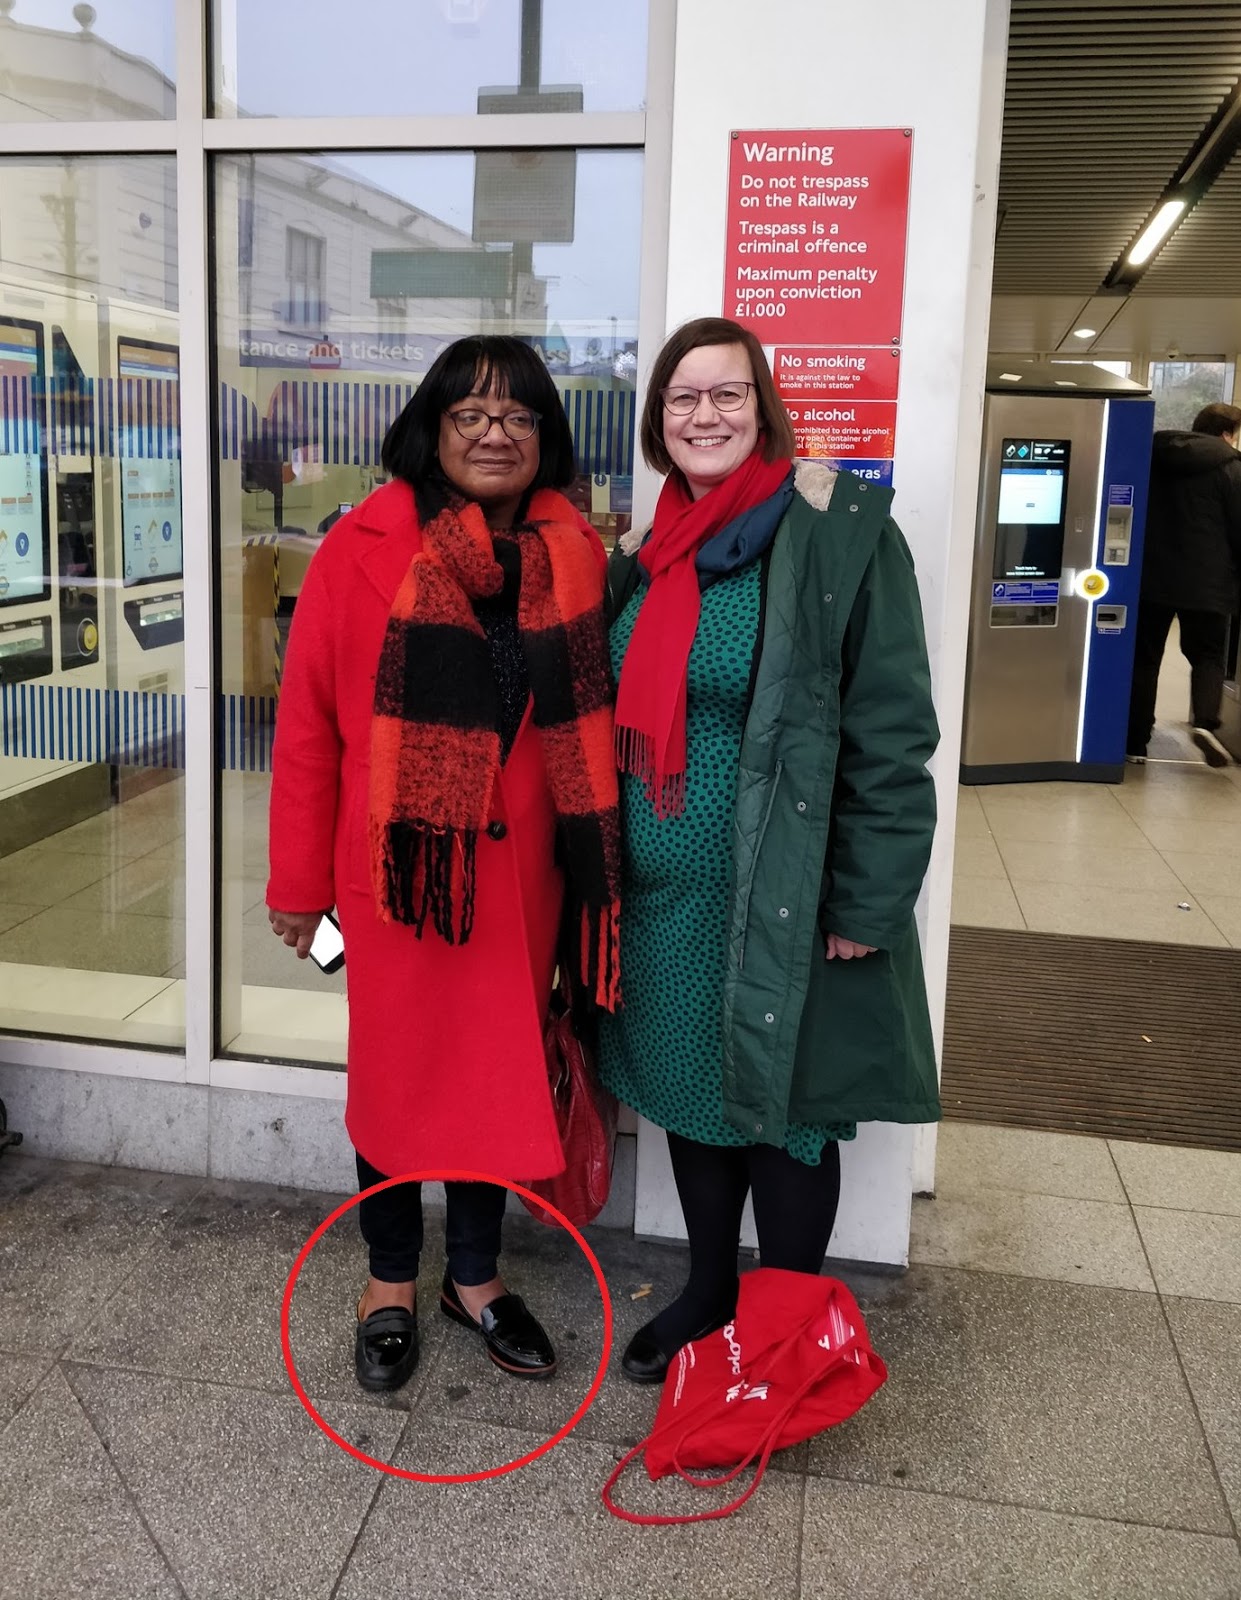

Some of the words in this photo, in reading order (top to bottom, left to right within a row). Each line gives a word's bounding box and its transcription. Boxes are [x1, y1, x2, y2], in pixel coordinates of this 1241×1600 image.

[743, 142, 834, 166] Warning
[741, 175, 764, 189] Do
[769, 175, 796, 188] not
[802, 175, 869, 191] trespass
[740, 196, 760, 207] on
[765, 194, 792, 207] the
[798, 193, 857, 209] Railway
[739, 221, 806, 238] Trespass
[812, 221, 825, 234] is
[830, 223, 839, 234] a
[738, 239, 799, 253] criminal
[805, 239, 867, 253] offence
[737, 267, 812, 281] Maximum
[818, 267, 878, 283] penalty
[736, 287, 775, 302] upon
[780, 285, 862, 299] conviction
[305, 340, 344, 358] and
[350, 341, 425, 361] tickets
[780, 355, 802, 368] No
[807, 355, 866, 371] smoking
[796, 374, 821, 382] against
[786, 408, 799, 421] o
[803, 408, 856, 421] alcohol
[862, 427, 889, 435] alcohol
[852, 469, 881, 479] eras
